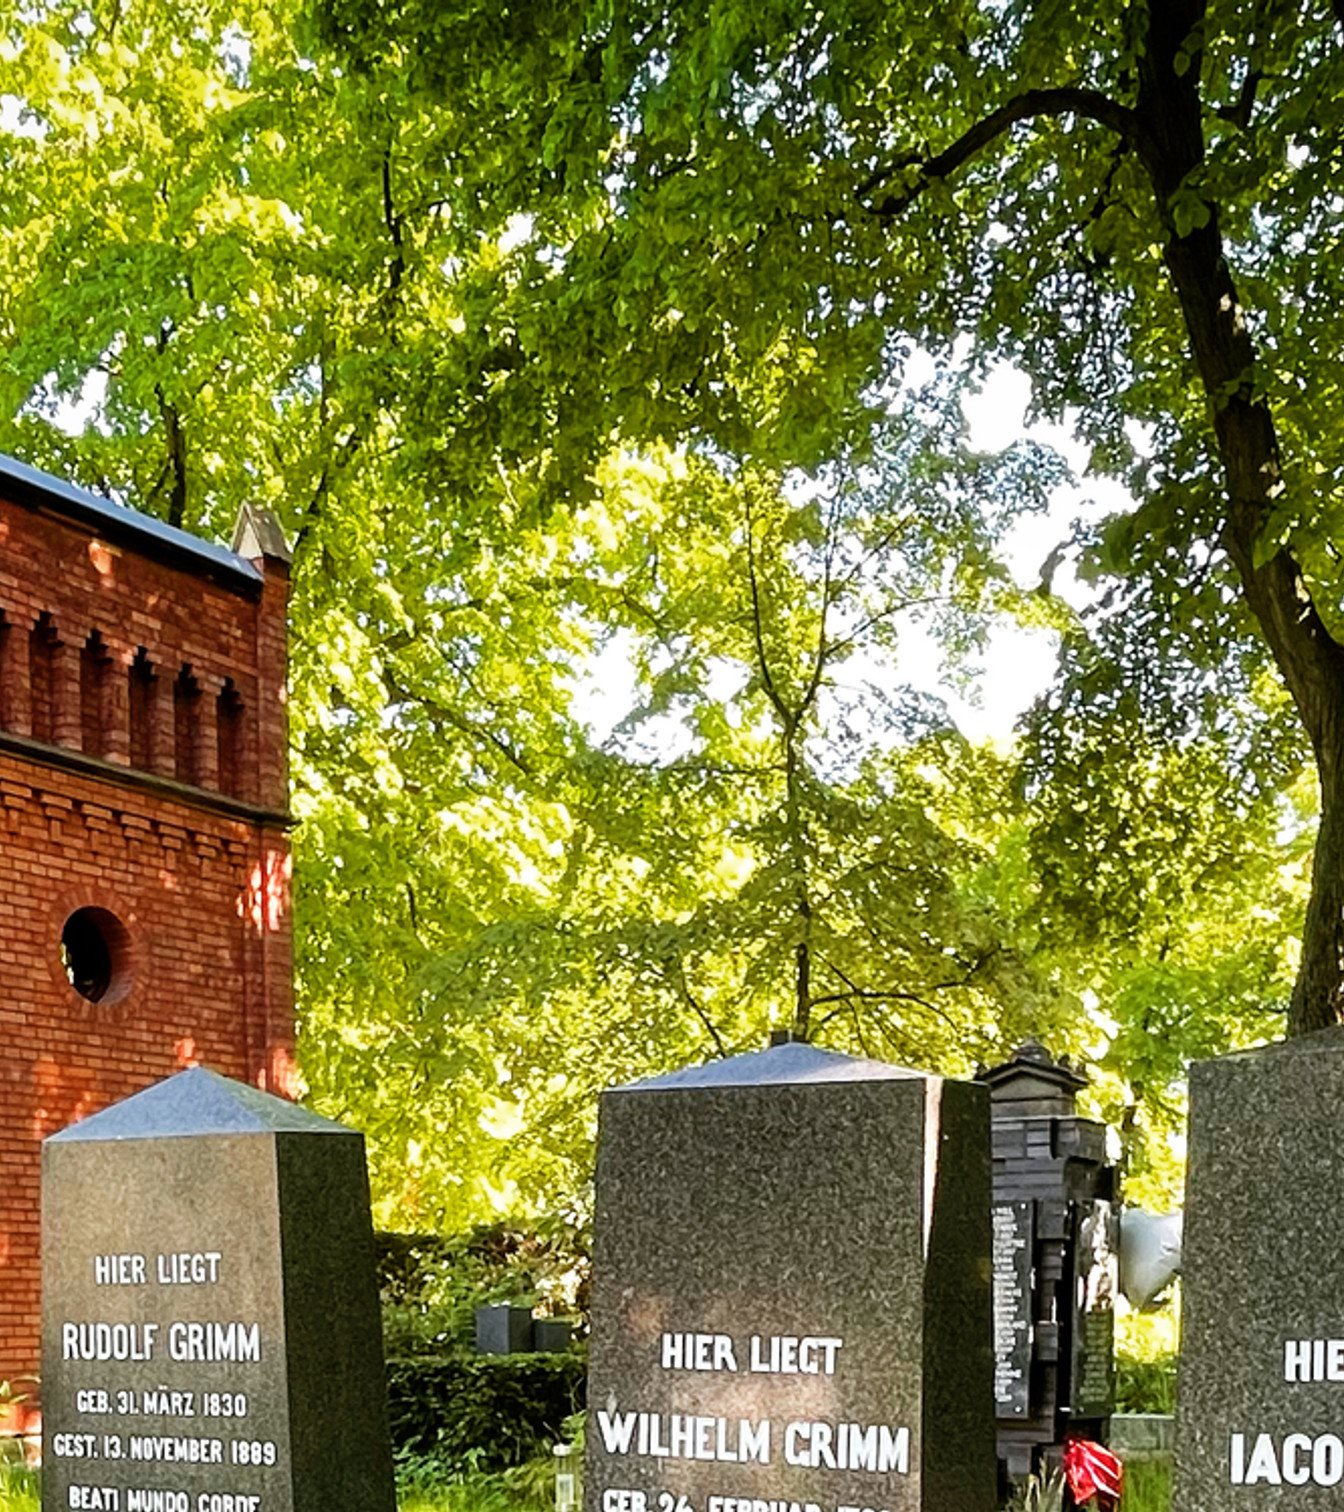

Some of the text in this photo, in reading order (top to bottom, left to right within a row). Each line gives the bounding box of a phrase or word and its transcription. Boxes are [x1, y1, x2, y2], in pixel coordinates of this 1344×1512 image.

[95, 1253, 221, 1284] HIER LIEGT
[62, 1322, 261, 1361] RUDOLF GRIMM
[662, 1332, 843, 1374] HIER LIEGT
[77, 1385, 247, 1417] GEB. 31. MÄRZ 1830
[54, 1434, 277, 1466] GEST. 13. NOVEMBER 1889
[597, 1411, 909, 1474] WILHELM GRIMM
[68, 1485, 119, 1511] BEATI
